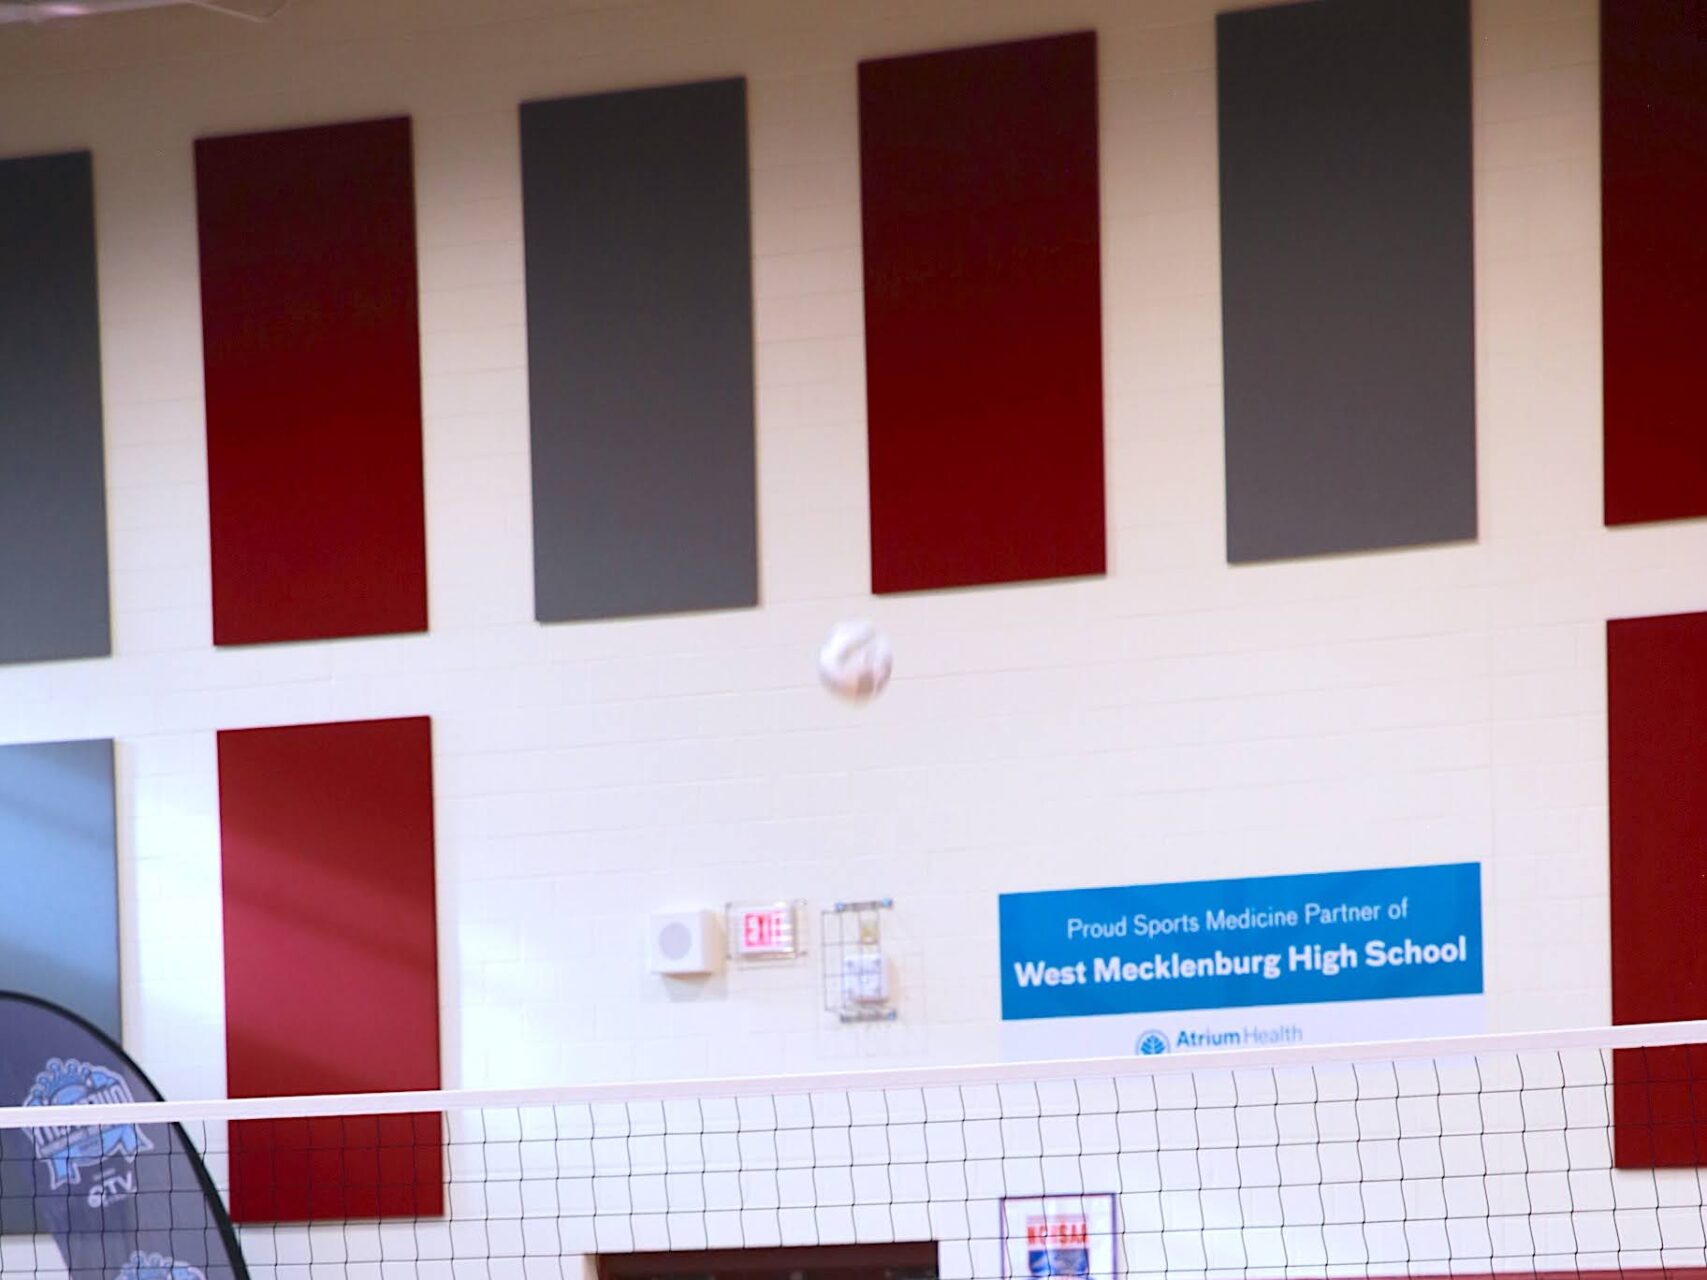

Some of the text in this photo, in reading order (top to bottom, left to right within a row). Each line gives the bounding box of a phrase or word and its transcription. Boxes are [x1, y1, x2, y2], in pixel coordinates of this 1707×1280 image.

[1067, 896, 1409, 940] Proud Sports Medicine Partner of
[1014, 934, 1467, 987] West Mecklenburg High School
[1176, 1024, 1303, 1047] Atrium Health
